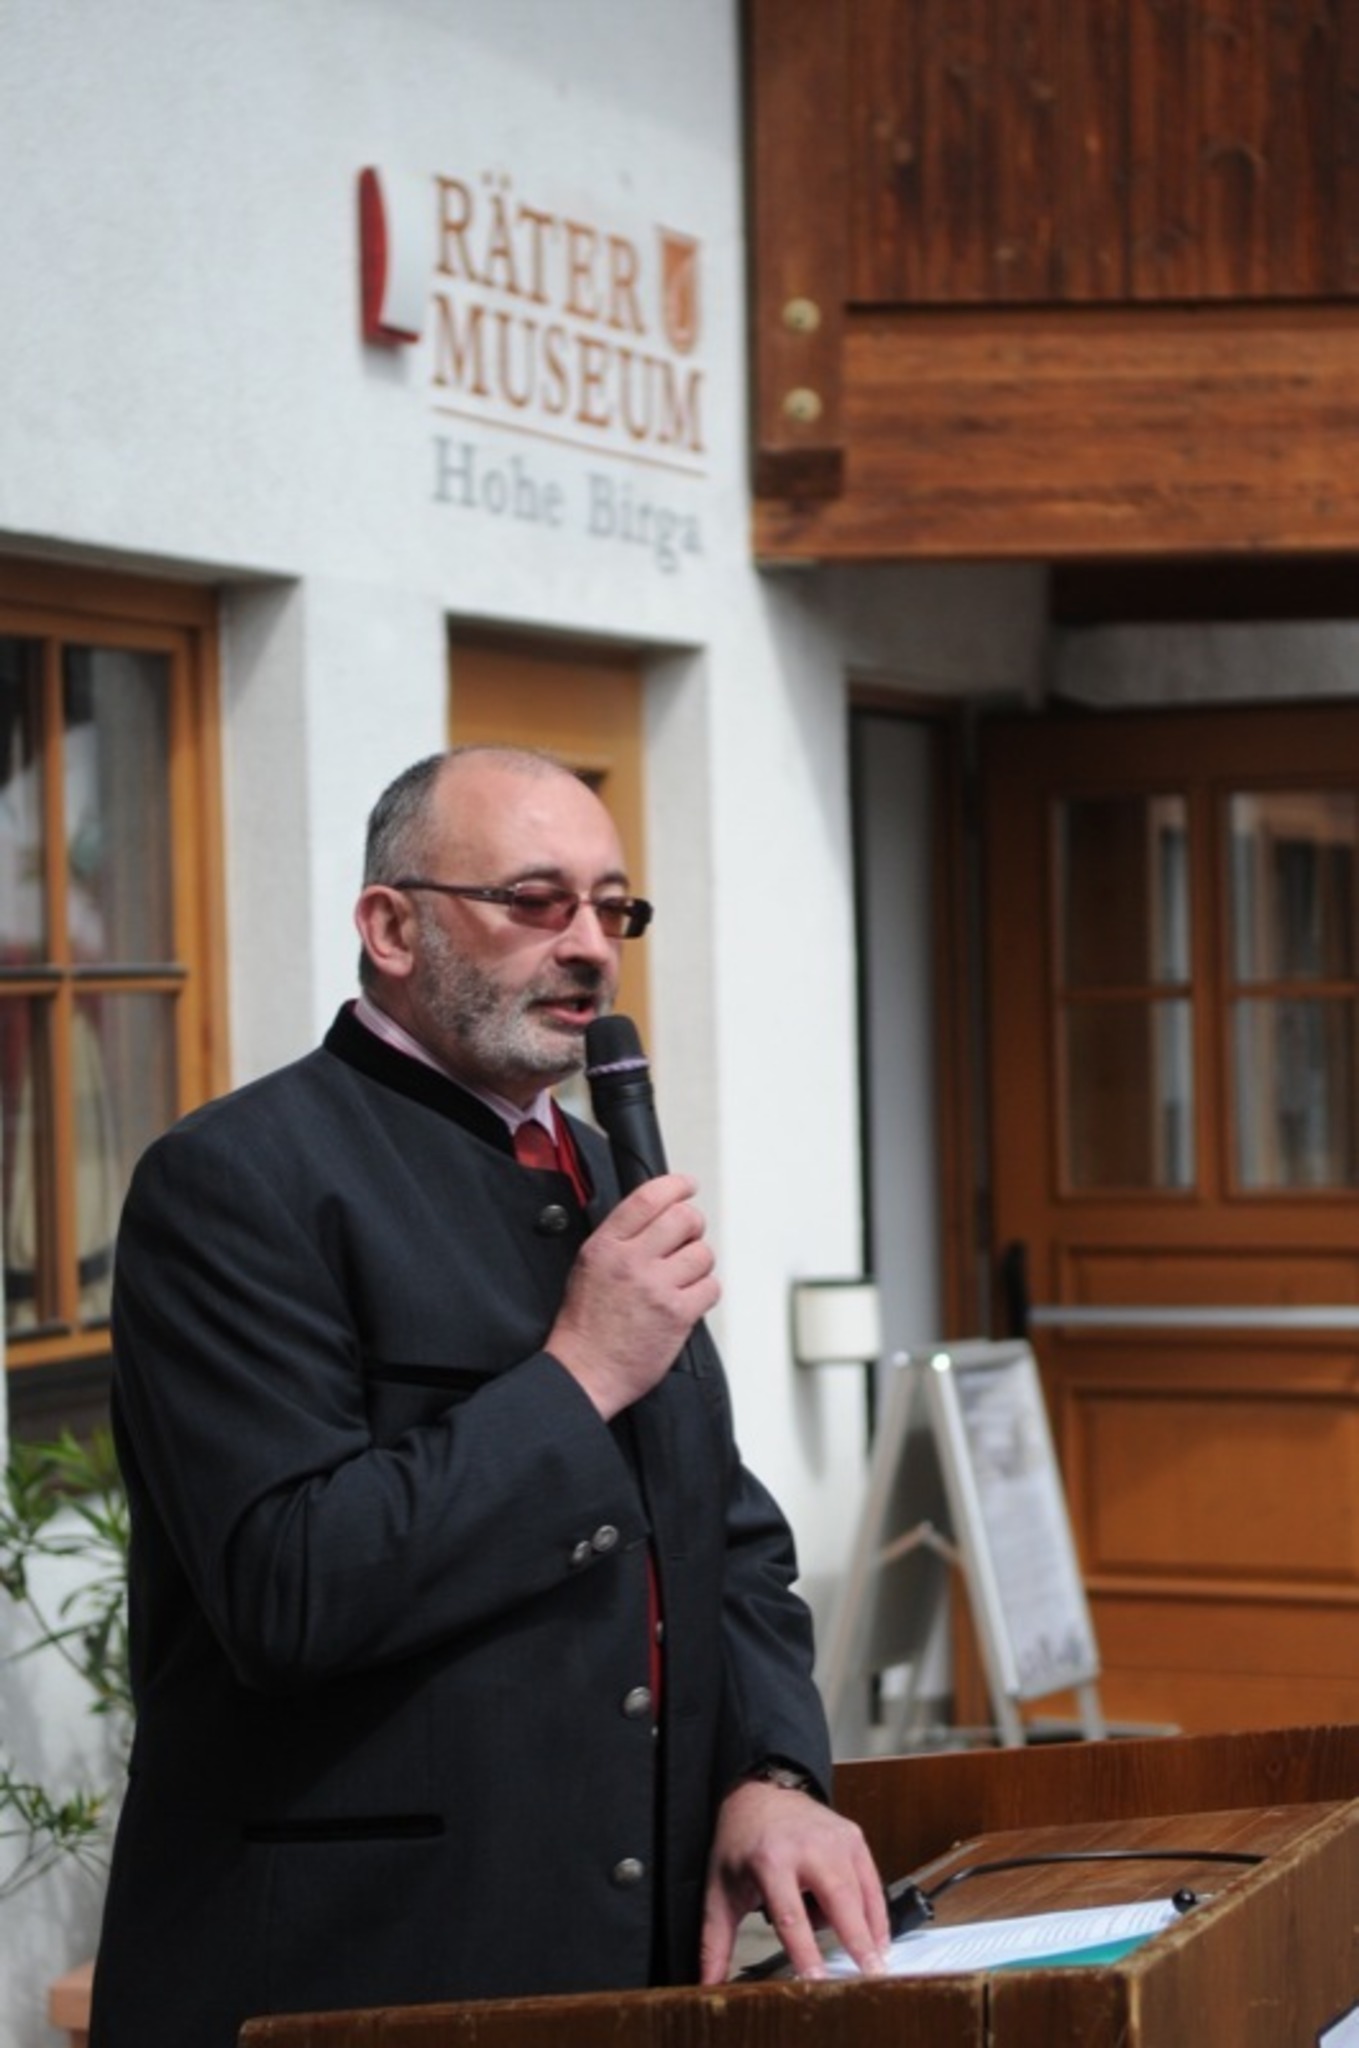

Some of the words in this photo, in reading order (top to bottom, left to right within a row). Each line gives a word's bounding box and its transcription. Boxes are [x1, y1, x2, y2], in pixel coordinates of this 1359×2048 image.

[434, 172, 645, 336] RÄTER
[433, 292, 705, 453] MUSEUM
[432, 435, 563, 528] Hohe
[586, 472, 703, 575] Birga
